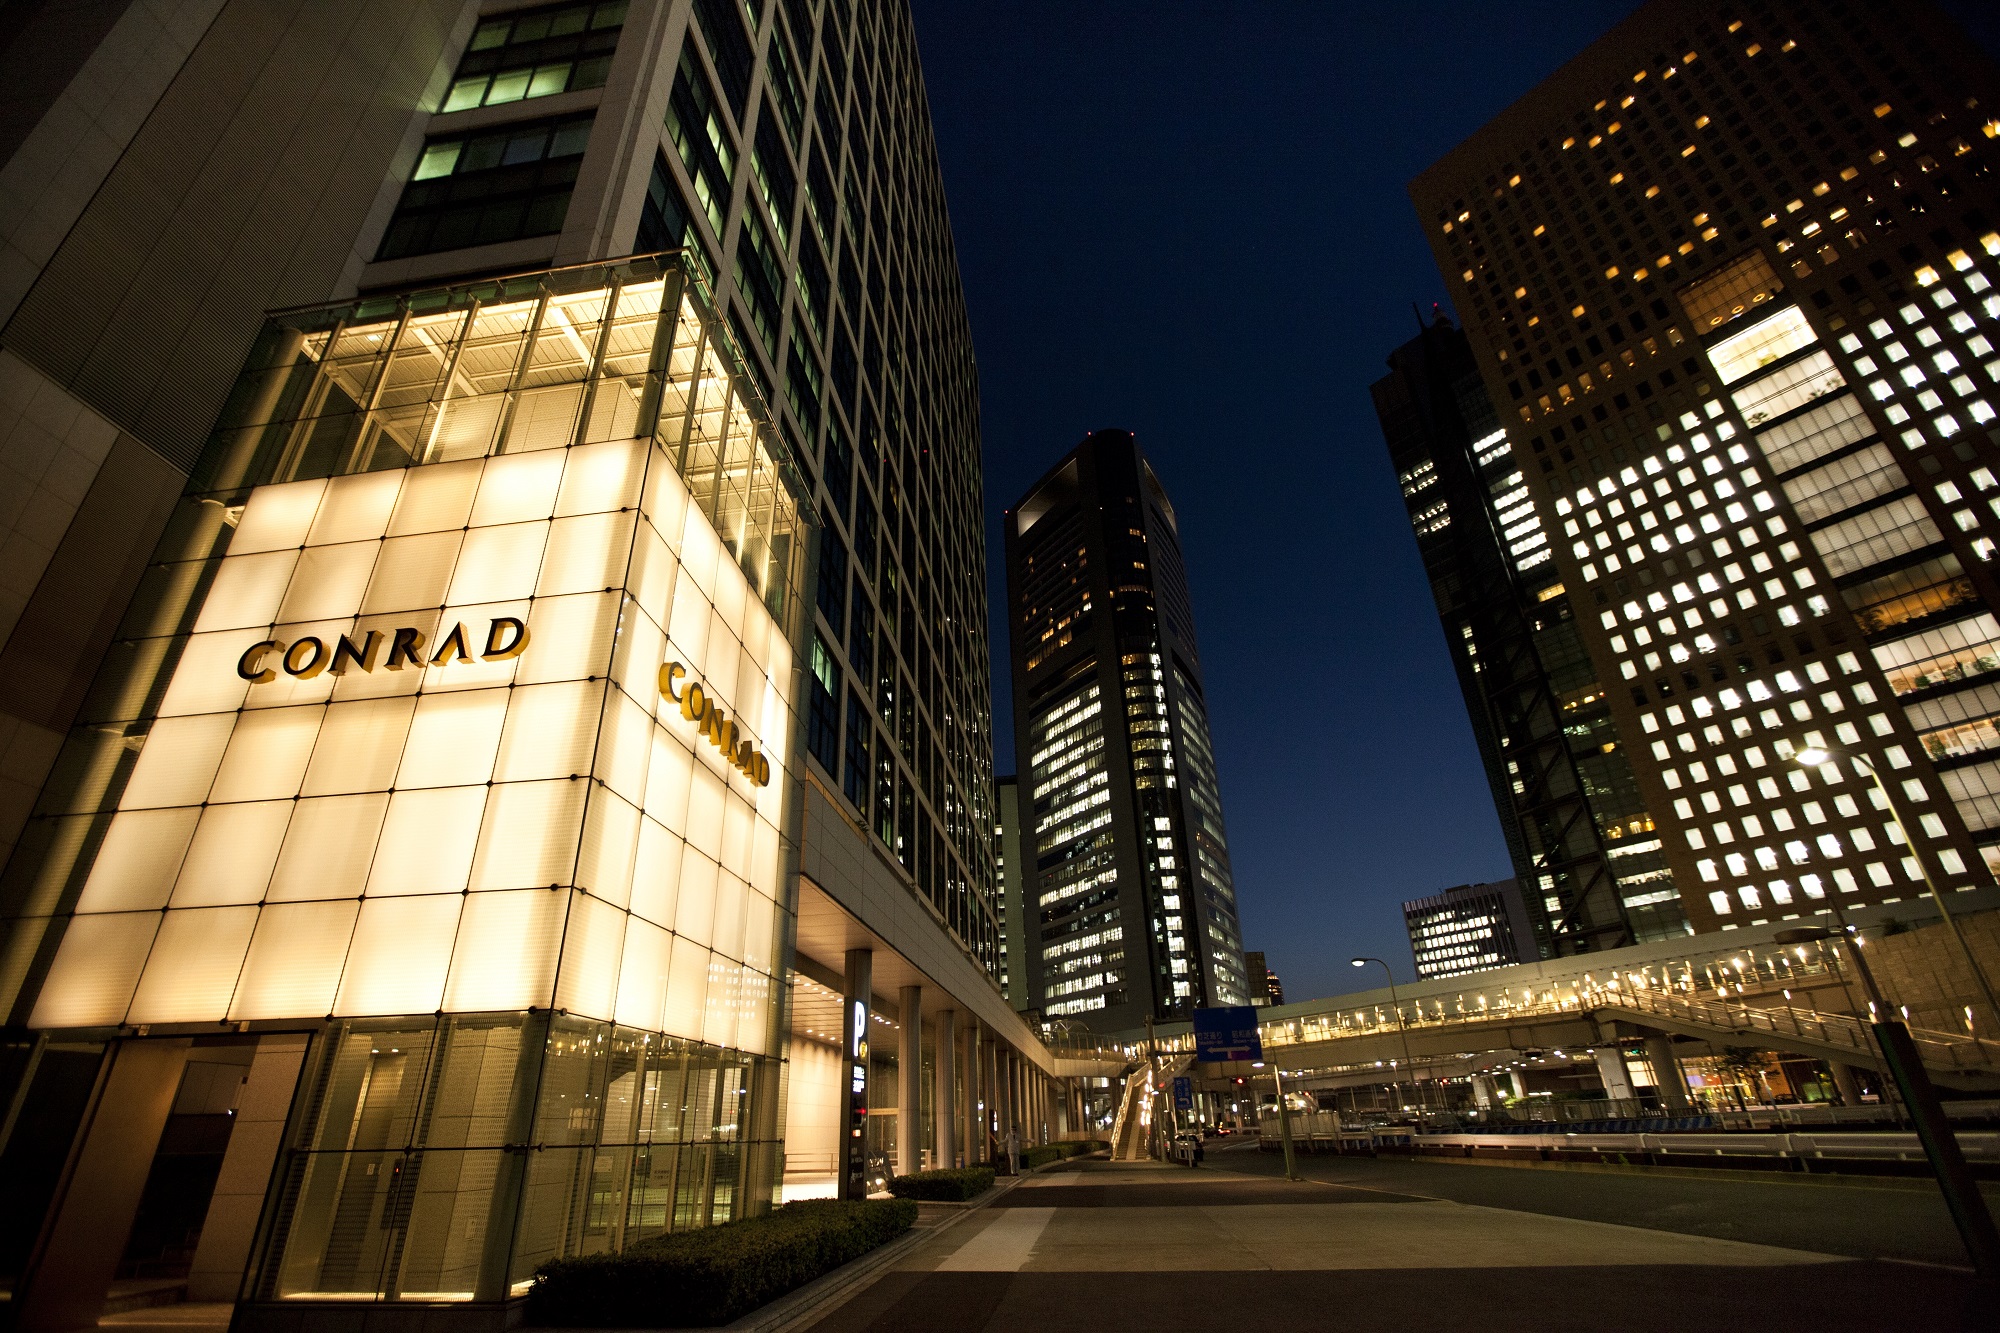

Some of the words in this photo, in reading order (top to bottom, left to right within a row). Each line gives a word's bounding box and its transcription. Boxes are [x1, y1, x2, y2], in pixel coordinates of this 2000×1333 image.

[237, 616, 530, 684] CONRAD
[658, 661, 771, 787] CONRAD
[854, 1001, 865, 1057] P
